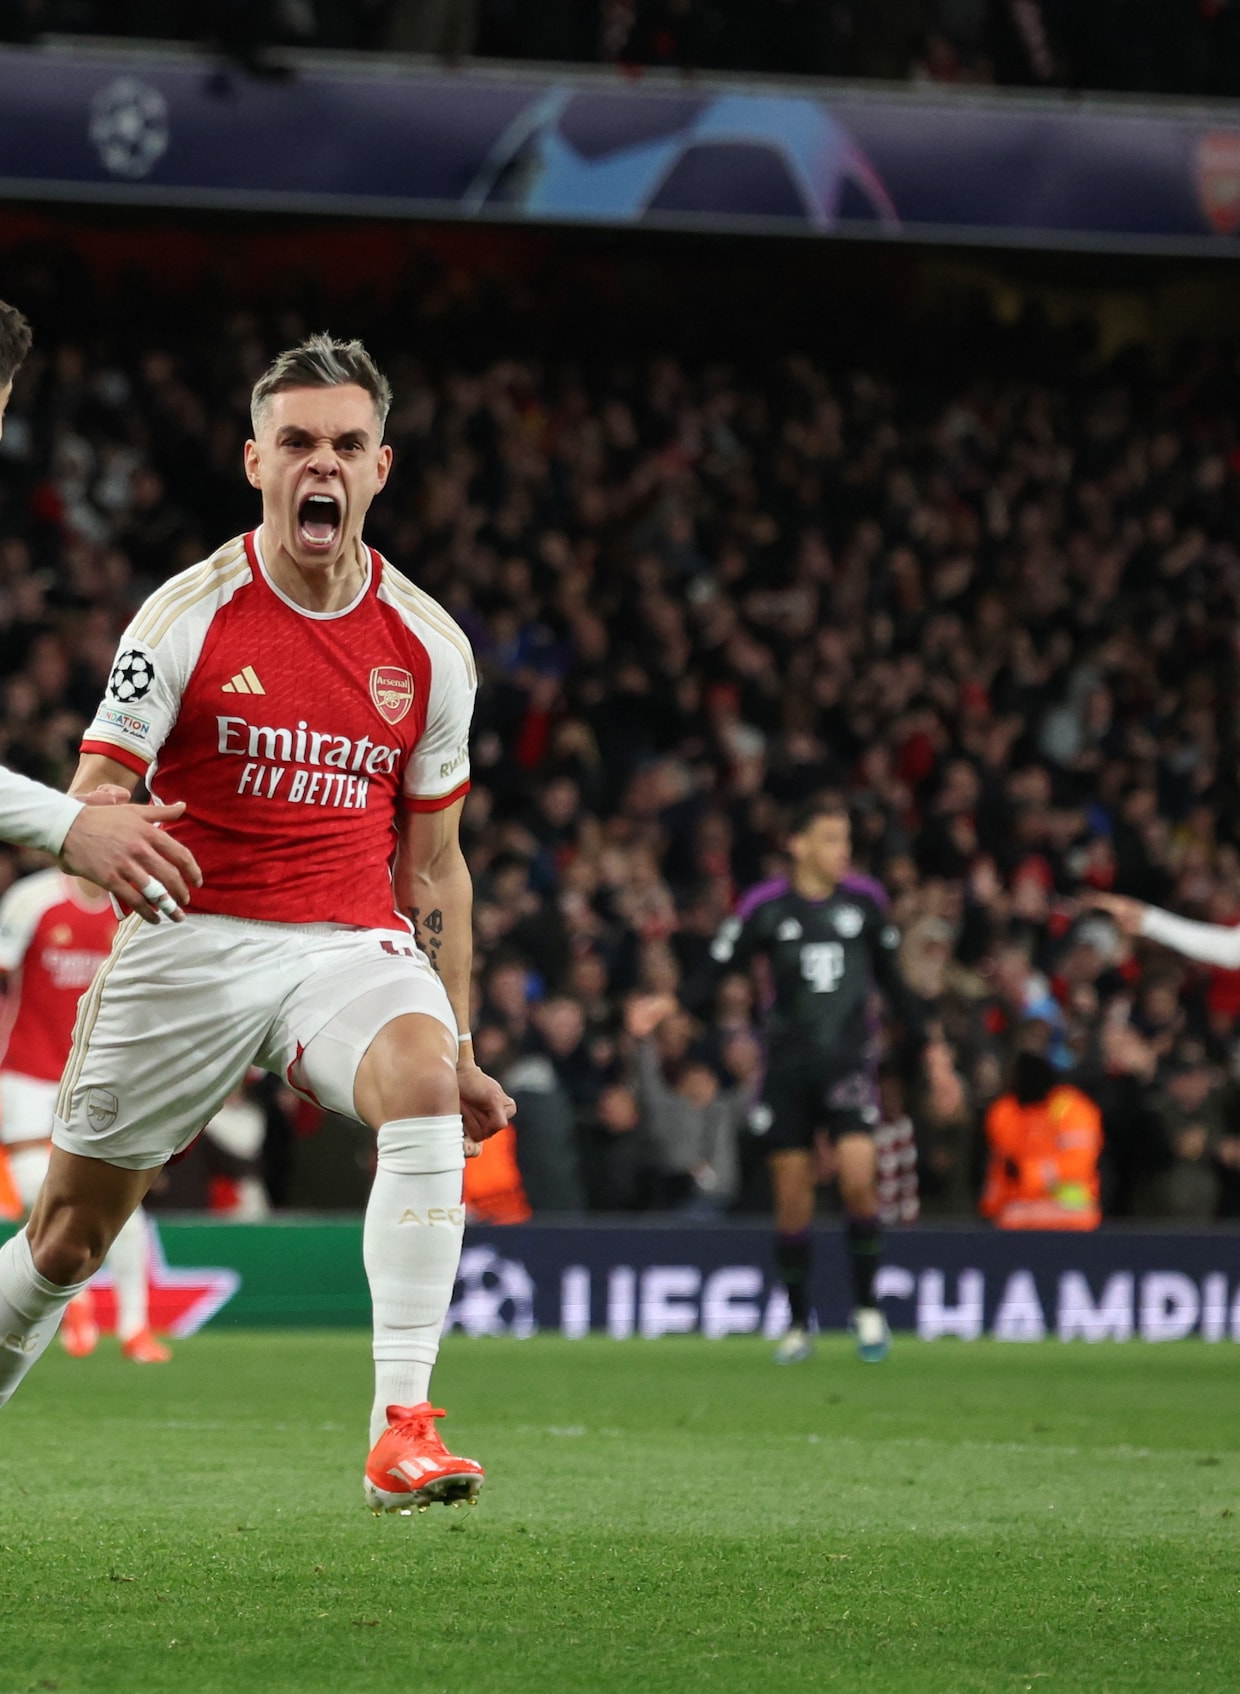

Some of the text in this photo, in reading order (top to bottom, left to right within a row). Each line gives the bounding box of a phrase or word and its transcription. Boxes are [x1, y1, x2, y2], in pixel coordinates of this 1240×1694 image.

[376, 675, 408, 689] Arsenal
[216, 715, 402, 775] Emirates
[237, 763, 370, 809] FLY BETTER
